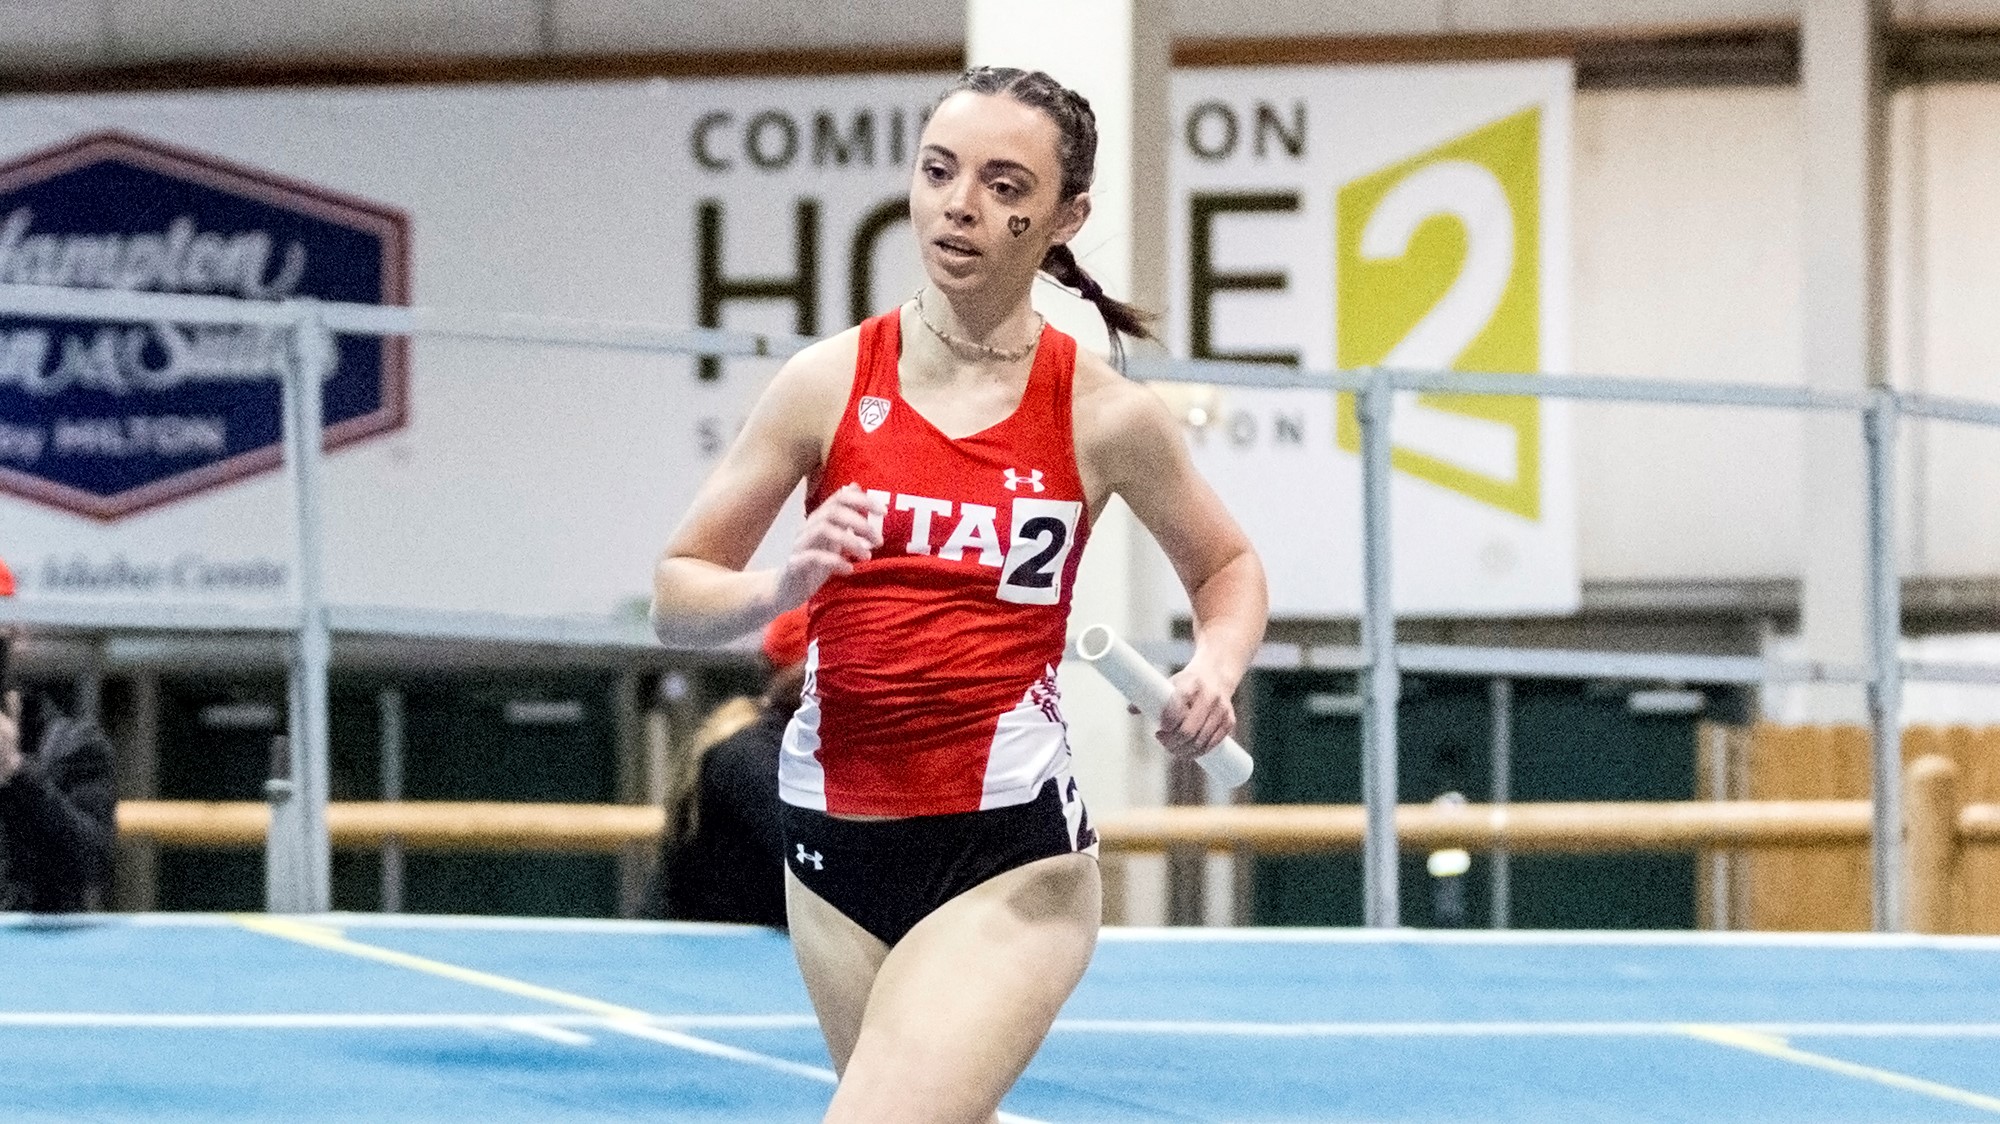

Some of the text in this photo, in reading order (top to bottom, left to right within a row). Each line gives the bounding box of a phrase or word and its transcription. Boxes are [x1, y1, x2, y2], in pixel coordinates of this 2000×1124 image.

[690, 101, 1308, 172] COMI ON
[1361, 158, 1519, 487] 2
[863, 412, 880, 426] 12
[867, 489, 1005, 568] TA
[1006, 516, 1068, 589] 2
